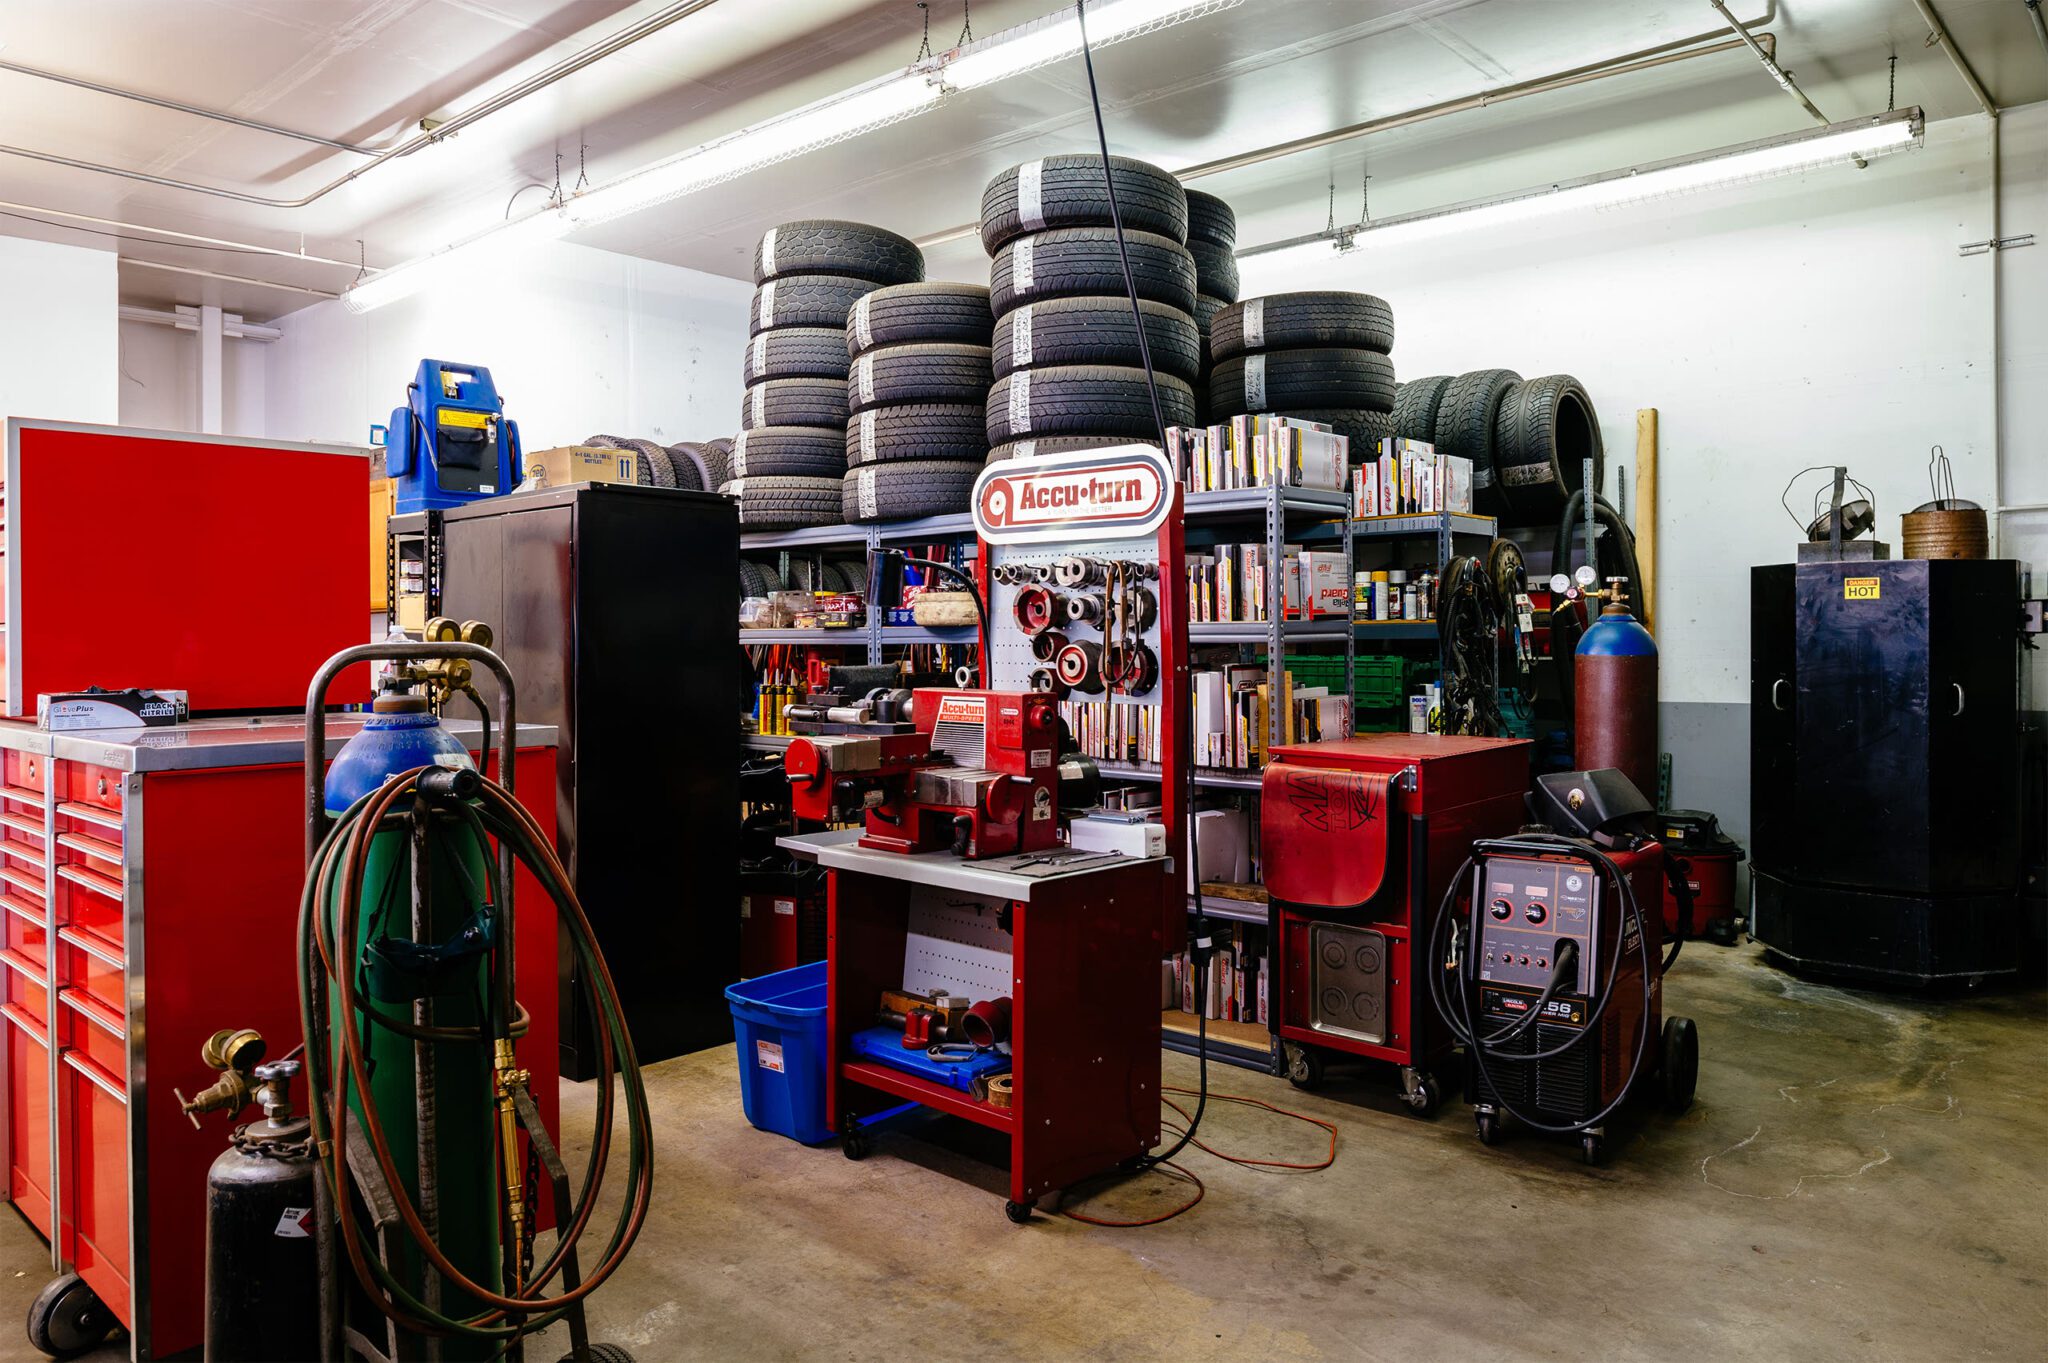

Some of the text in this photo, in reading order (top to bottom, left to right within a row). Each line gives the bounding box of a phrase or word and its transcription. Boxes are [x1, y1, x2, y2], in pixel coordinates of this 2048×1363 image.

[1321, 589, 1348, 600] Guard
[1849, 587, 1876, 596] HOT
[140, 709, 174, 717] NITRILE
[1544, 1001, 1571, 1014] 56
